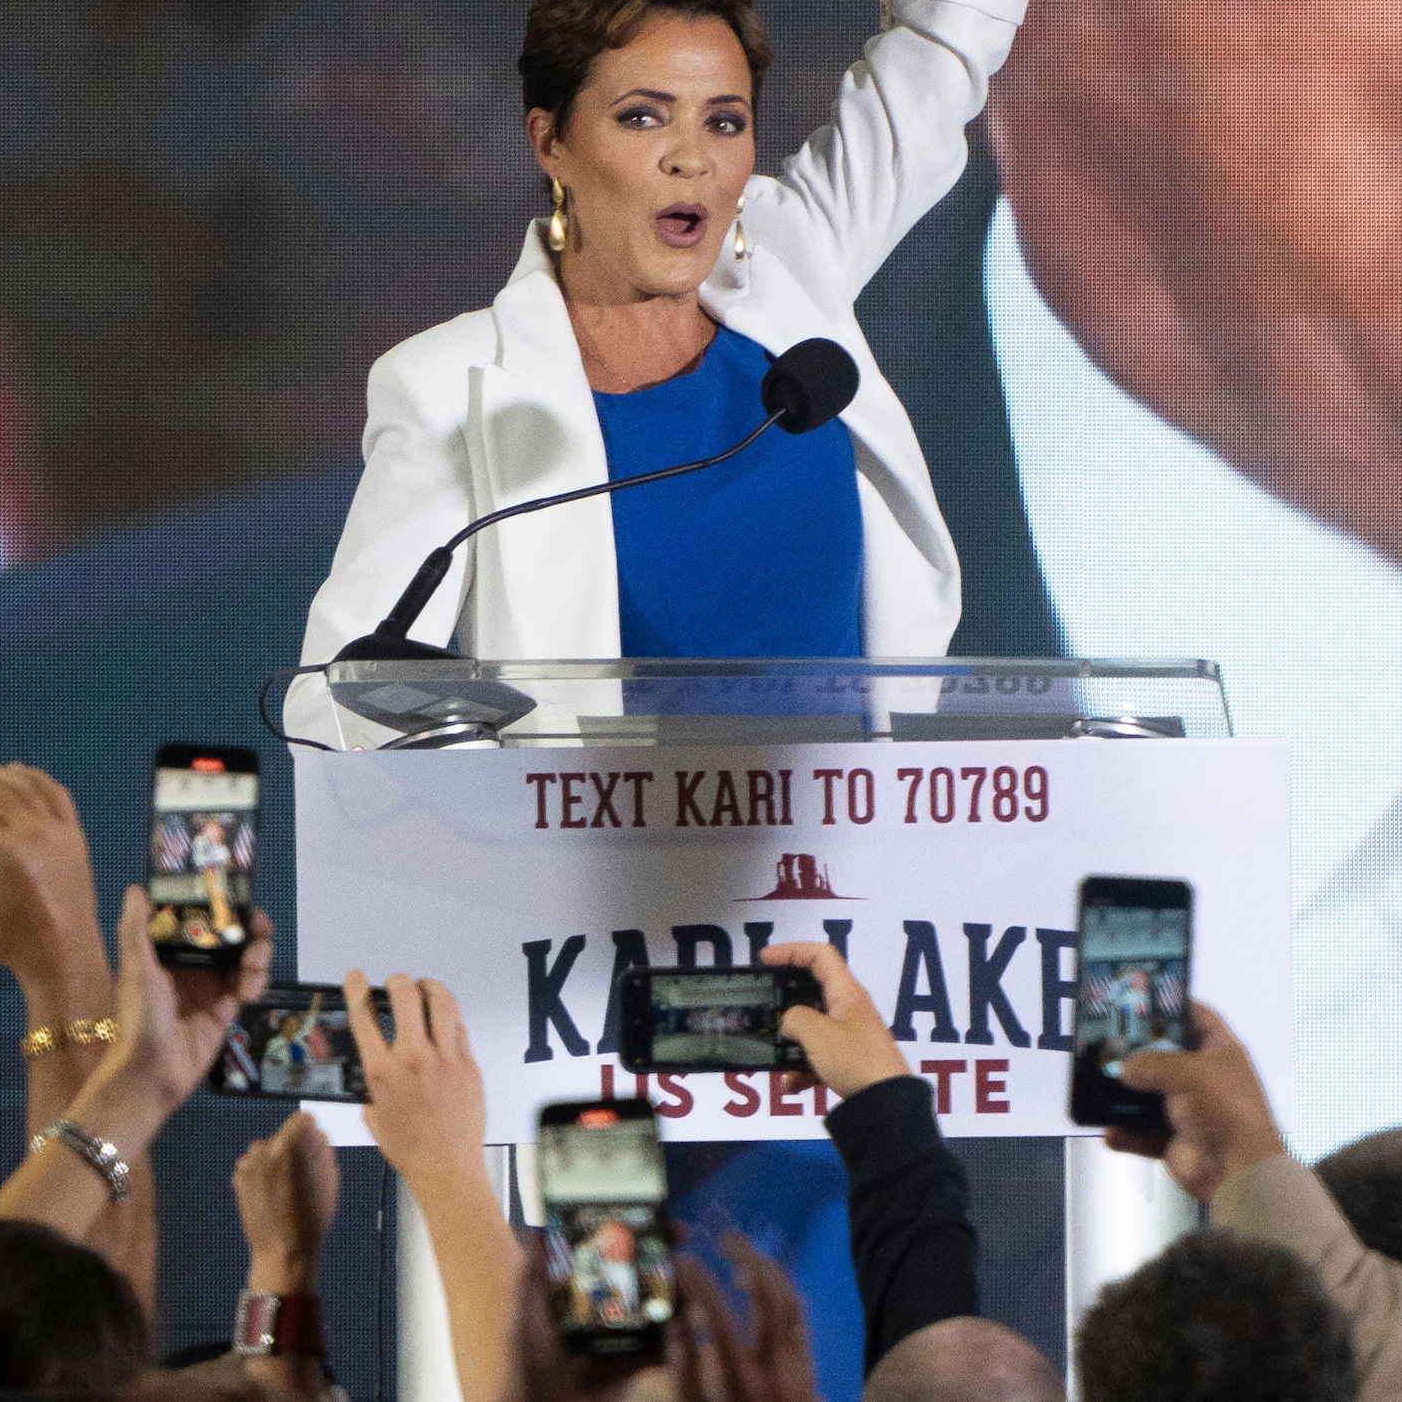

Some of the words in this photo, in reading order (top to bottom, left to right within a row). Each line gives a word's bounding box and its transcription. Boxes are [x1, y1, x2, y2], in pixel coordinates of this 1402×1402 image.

[526, 772, 654, 829] TEXT
[675, 769, 793, 827] KARI
[813, 768, 875, 825] TO
[897, 765, 1050, 824] 70789
[823, 919, 1079, 1051] AKE
[723, 1059, 1010, 1117] SETE
